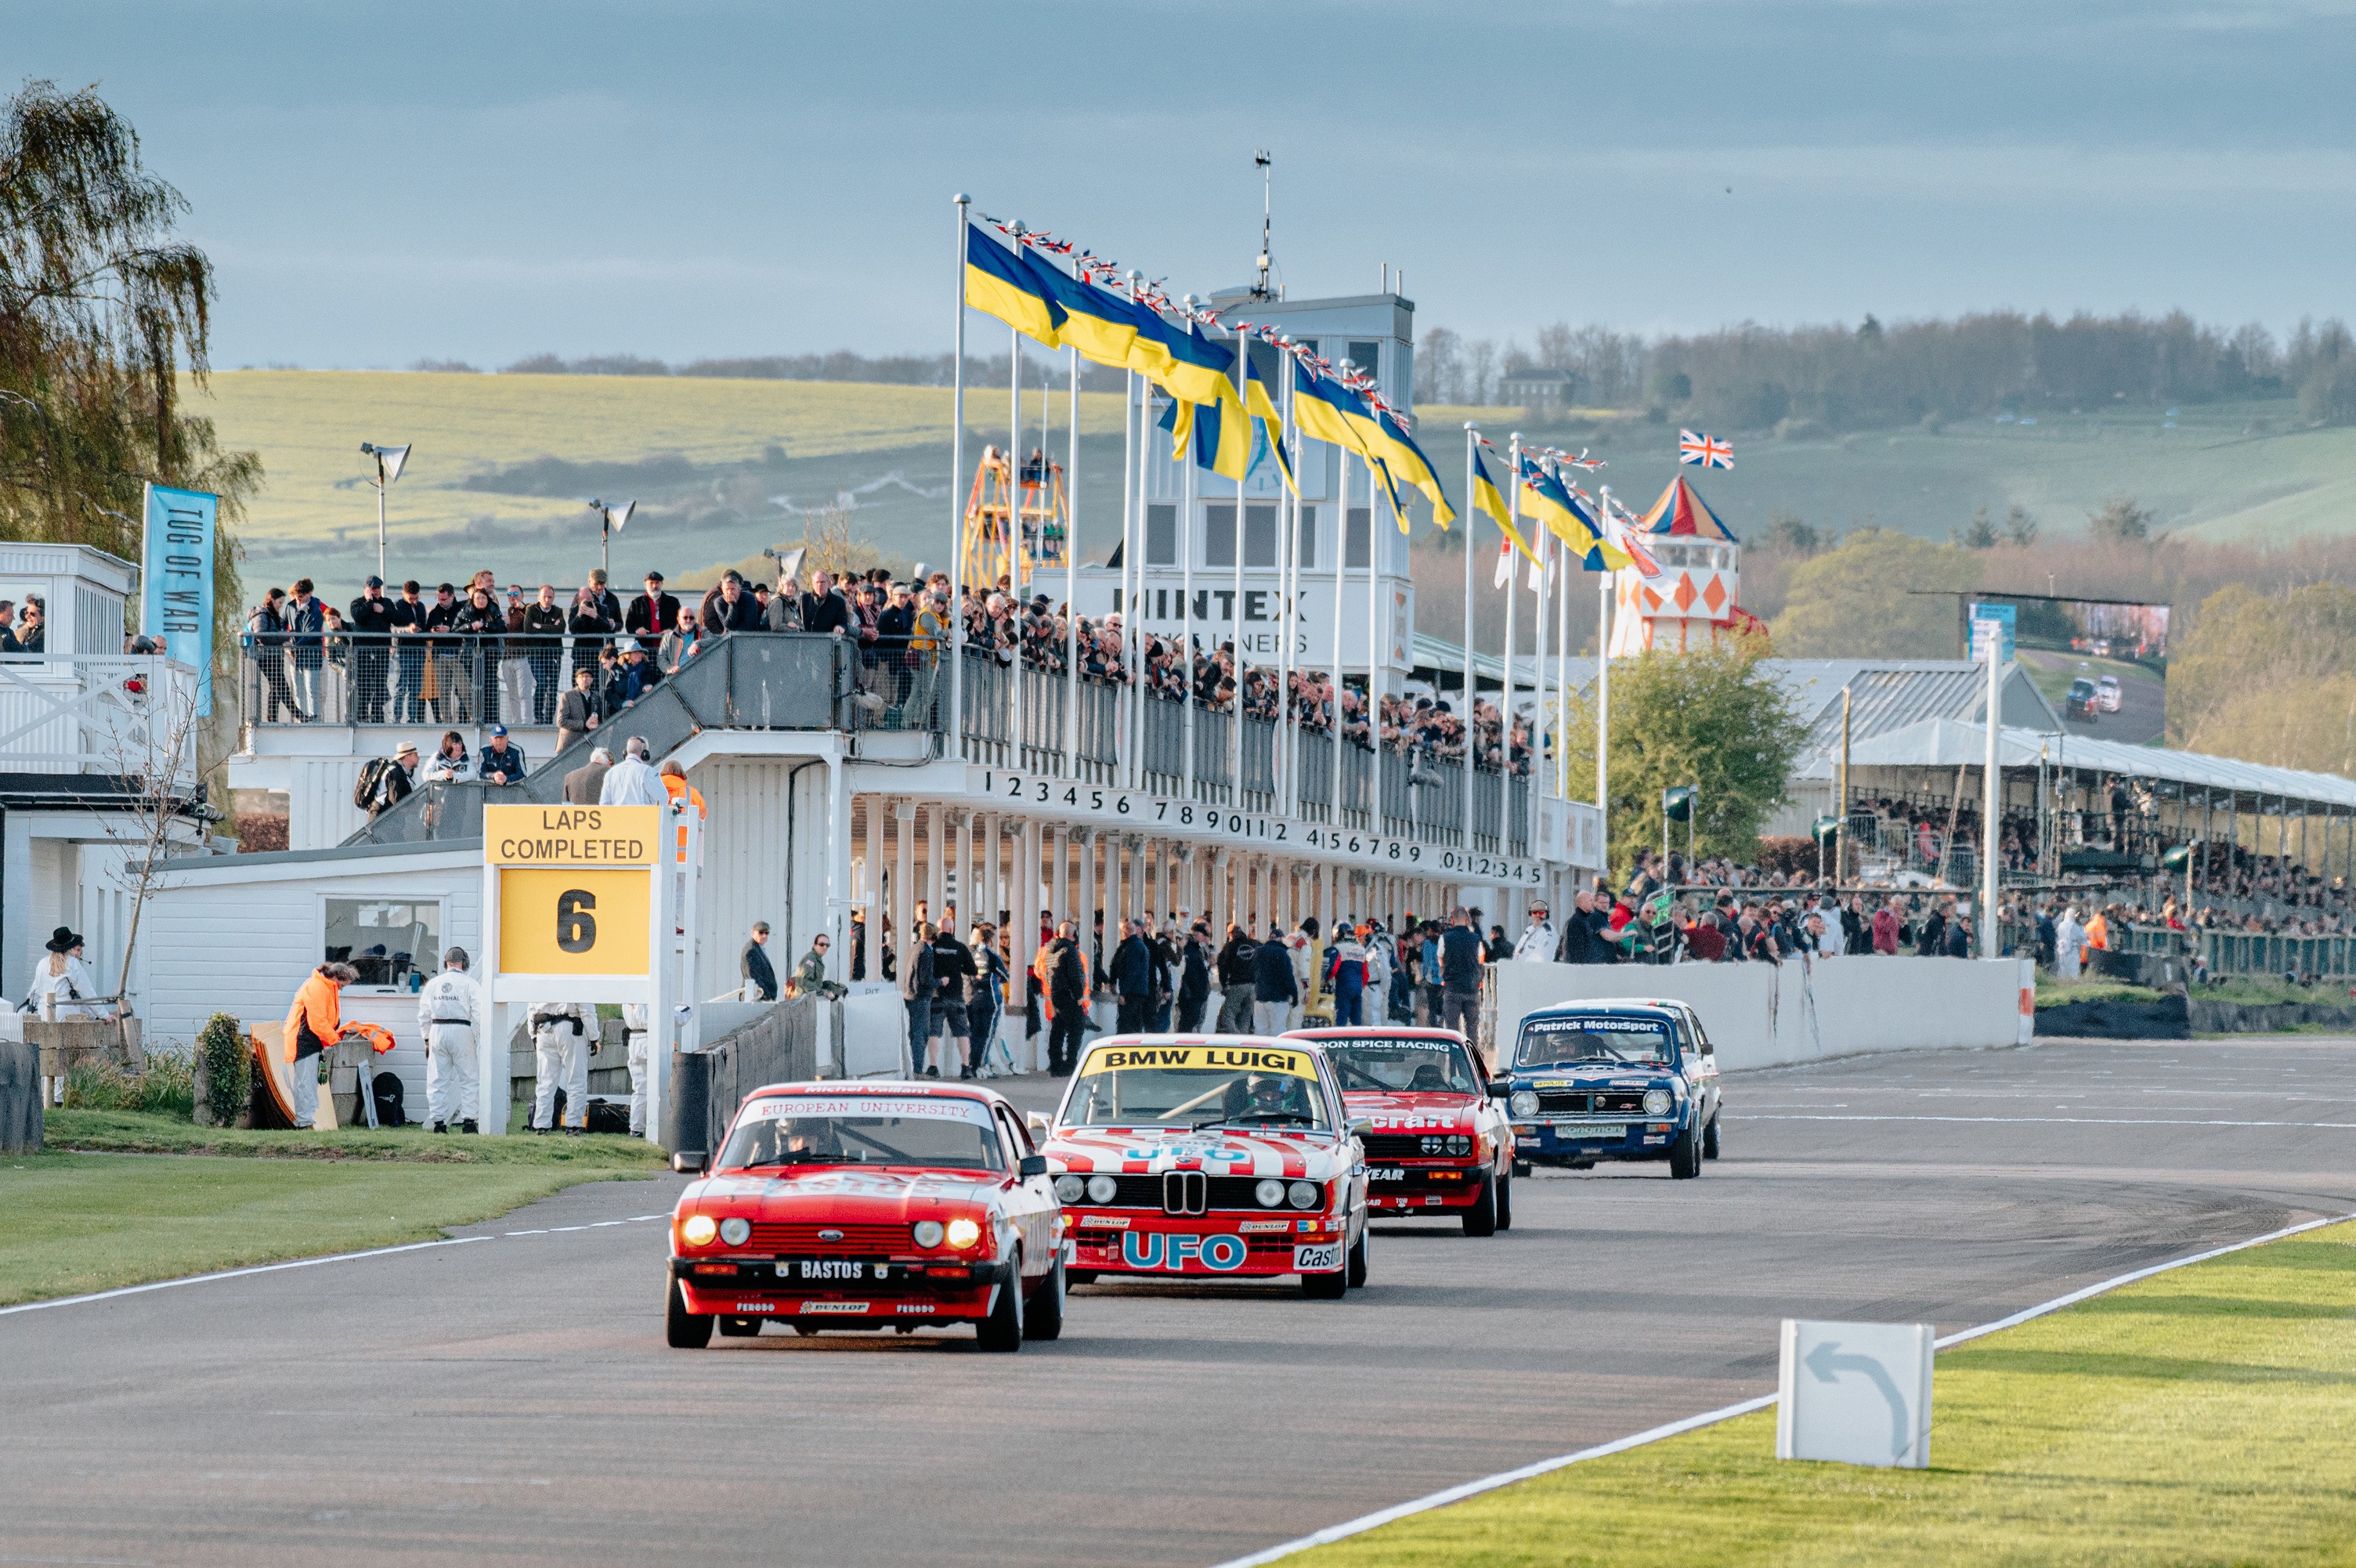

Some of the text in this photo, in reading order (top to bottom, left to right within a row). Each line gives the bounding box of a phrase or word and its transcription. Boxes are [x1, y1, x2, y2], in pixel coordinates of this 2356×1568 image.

[163, 508, 204, 634] TUG OF WAR
[985, 771, 991, 792] 1
[1008, 777, 1021, 797] 2
[1036, 782, 1049, 801] 3
[1063, 786, 1077, 806] 4
[1091, 791, 1103, 810] 5
[1117, 796, 1129, 814] 6
[1155, 802, 1167, 820] 7
[1180, 806, 1193, 824] 8
[1207, 811, 1219, 829] 9
[543, 810, 602, 830] LAPS
[500, 839, 644, 859] COMPLETED
[557, 888, 597, 954] 6
[1534, 1021, 1581, 1032] Patrick
[1317, 1040, 1450, 1053] DON SPICE RACING
[1104, 1050, 1296, 1071] BMW LUIGI
[804, 1085, 930, 1095] Michel Vaillant
[762, 1102, 970, 1118] EUROPEAN UNIVERSITY
[1351, 1114, 1454, 1129] craft
[1367, 1169, 1405, 1181] YEAR
[735, 1176, 942, 1194] BASTOS
[1123, 1230, 1248, 1270] UFO
[800, 1260, 862, 1279] BASTOS
[736, 1302, 775, 1312] FERODO
[896, 1304, 935, 1313] FERODO
